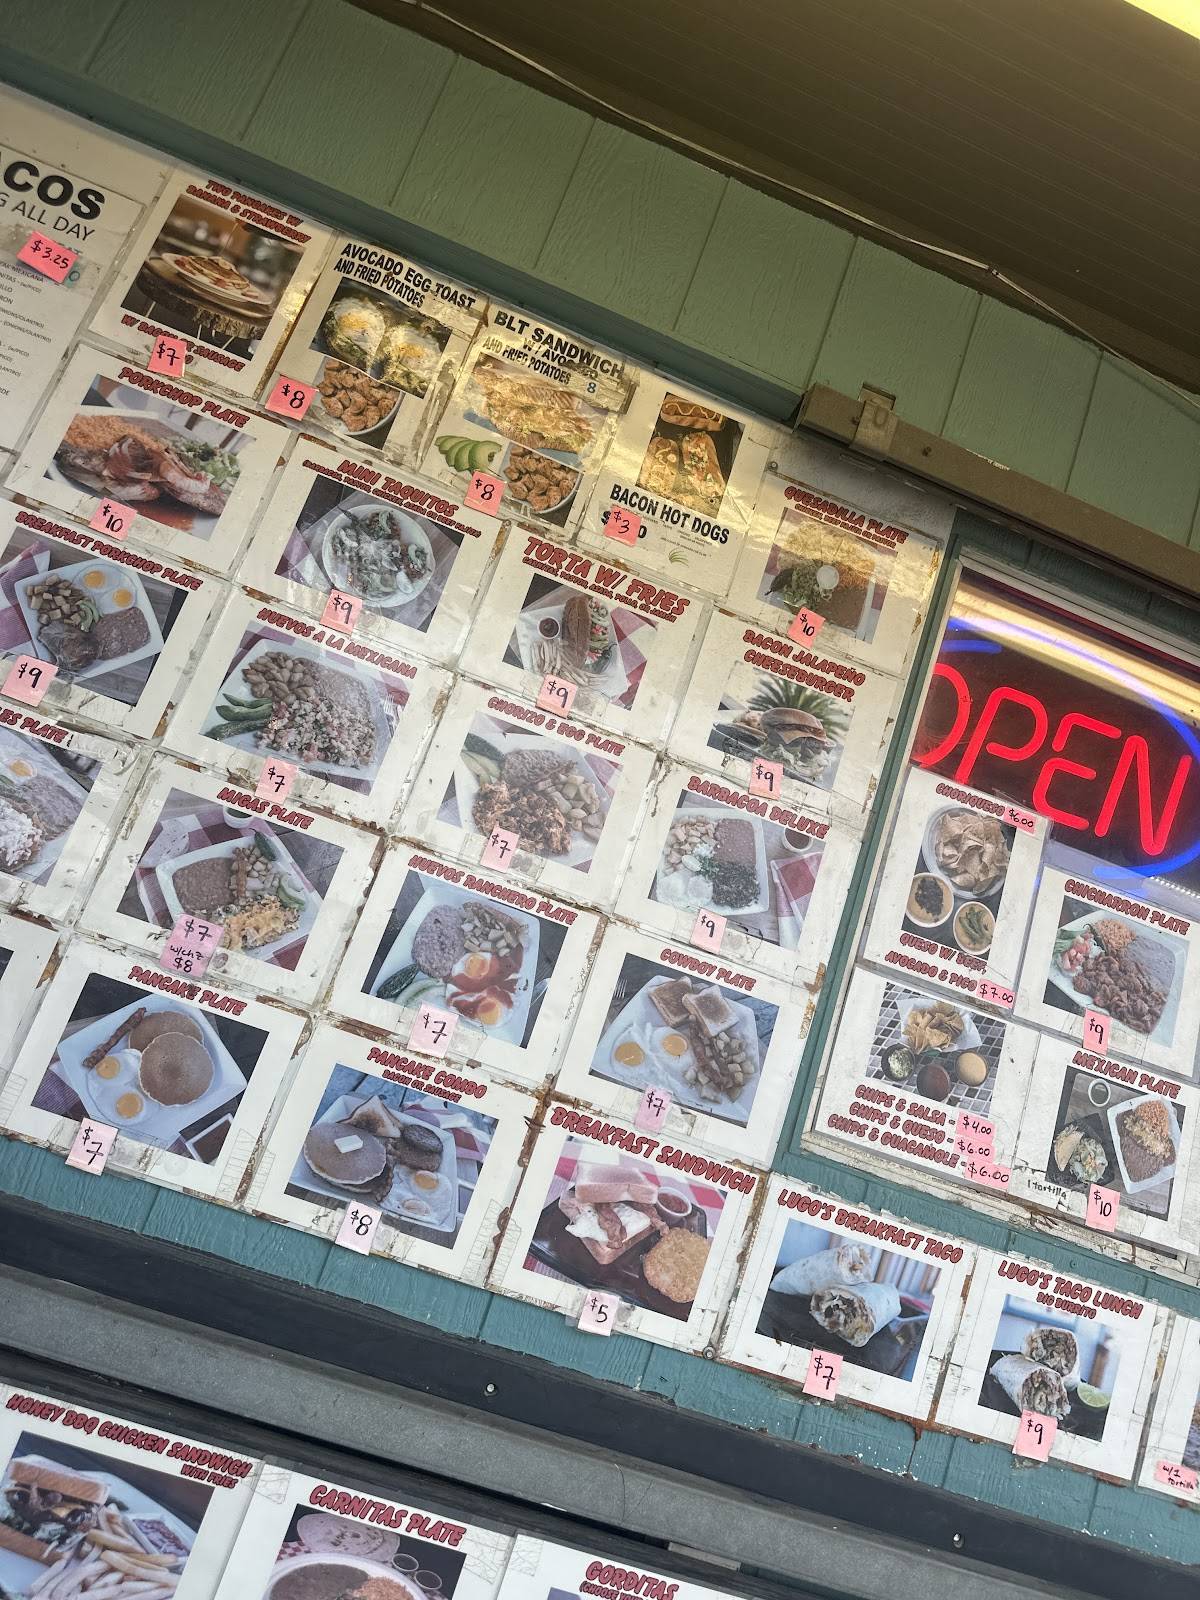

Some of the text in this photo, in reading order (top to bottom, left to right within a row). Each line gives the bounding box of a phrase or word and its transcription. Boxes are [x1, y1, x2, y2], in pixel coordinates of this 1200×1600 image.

[0, 160, 105, 220] COS
[206, 179, 232, 198] TWO
[230, 191, 287, 221] PANCAKES
[12, 200, 95, 241] ALL DAY
[185, 184, 231, 210] BANANA
[240, 207, 312, 243] STRAWBERRY
[30, 239, 70, 270] $3.25
[333, 257, 425, 308] AND FRIED POTATOES
[340, 242, 476, 311] AVOCADO EGG TOAST
[157, 340, 180, 366] $7
[193, 345, 246, 372] SAUSAGE
[493, 311, 530, 337] BLT
[531, 327, 624, 380] SANDWICH
[502, 344, 528, 366] FRIED
[527, 355, 572, 385] POTATOES
[117, 367, 251, 428] PORKCHOP PLATE
[281, 383, 305, 409] $8
[337, 460, 381, 485] MINI
[381, 476, 459, 517] TAQUITOS
[475, 478, 494, 501] $8
[102, 503, 124, 533] $10
[610, 484, 658, 516] BACON
[660, 504, 690, 529] HOT
[691, 517, 729, 545] DOGS
[614, 511, 631, 534] $3
[784, 485, 866, 528] QUESADILLA
[866, 517, 910, 545] PLATE
[15, 510, 204, 591] BREAKFAST PORKCHOP PLATE
[523, 536, 691, 616] TORTA W/ FRIES
[333, 595, 353, 625] $9
[799, 613, 815, 638] $10
[256, 607, 418, 680] HUEVOS A LA MEXICANA
[743, 629, 793, 659] BACON
[18, 662, 43, 689] $9
[743, 649, 855, 703] CHEESEBURGER
[546, 680, 569, 709] $9
[19, 716, 69, 744] PLATE
[487, 695, 546, 727] CHORIZO
[556, 722, 587, 742] EGG
[586, 733, 626, 757] PLATE
[755, 763, 774, 791] $9
[910, 662, 1193, 856] OPEN
[268, 766, 286, 792] $7
[216, 787, 315, 830] MIGAS PLATE
[687, 775, 830, 839] BARBACOA DELUXE
[935, 782, 1006, 817] CHORIQUESO
[1008, 807, 1035, 828] $6.00
[491, 833, 511, 859] $7
[407, 854, 579, 926] HUEVOS RANCHERO PLATE
[1064, 878, 1191, 936] CHICHARRON PLATE
[184, 919, 212, 942] $7
[700, 914, 715, 939] $9
[173, 956, 193, 973] $8
[899, 932, 938, 955] QUESO
[939, 945, 957, 961] W/
[659, 948, 757, 992] COWBOY PLATE
[884, 950, 939, 978] AVOCADO
[948, 972, 978, 992] PICO
[127, 965, 248, 1016] PANCAKE PLATE
[980, 983, 1015, 1006] $7.00
[423, 1012, 448, 1044] $7
[1089, 1017, 1104, 1045] $9
[366, 1046, 488, 1099] PANCAKE COMBO
[381, 1069, 462, 1104] BACON OR SAUSAGE
[1072, 1050, 1183, 1100] MEXICAN PLATE
[646, 1090, 666, 1118] $7
[855, 1084, 896, 1109] CHIPS
[906, 1102, 947, 1127] SALSA
[828, 1113, 869, 1138] CHIPS
[880, 1131, 961, 1169] GUACAMOLE
[849, 1101, 890, 1126] CHIPS
[902, 1119, 946, 1145] QUESO
[962, 1114, 993, 1136] $4.00
[83, 1126, 104, 1165] $7
[550, 1106, 757, 1196] BREAKFAST SANDWICH
[957, 1139, 991, 1157] $6.00
[967, 1161, 1010, 1184] $6.00
[1032, 1181, 1067, 1200] tortilla
[1093, 1190, 1112, 1218] $10
[350, 1209, 373, 1238] $8
[778, 1188, 965, 1264] LUGO'S BREAKFAST TACO
[997, 1259, 1144, 1320] LUGO'S TACO LUNCH
[1035, 1291, 1098, 1320] BIG BURRITO
[590, 1296, 608, 1324] $5
[813, 1354, 836, 1391] $7
[5, 1394, 254, 1478] HONEY BBQ CHICKEN SANDWICH
[1027, 1419, 1044, 1446] $9
[180, 1464, 240, 1490] WITH FRIES
[309, 1484, 467, 1547] CARNITAS PLATE
[578, 1580, 620, 1600] (CHOOSE
[585, 1560, 680, 1600] GORDITAS
